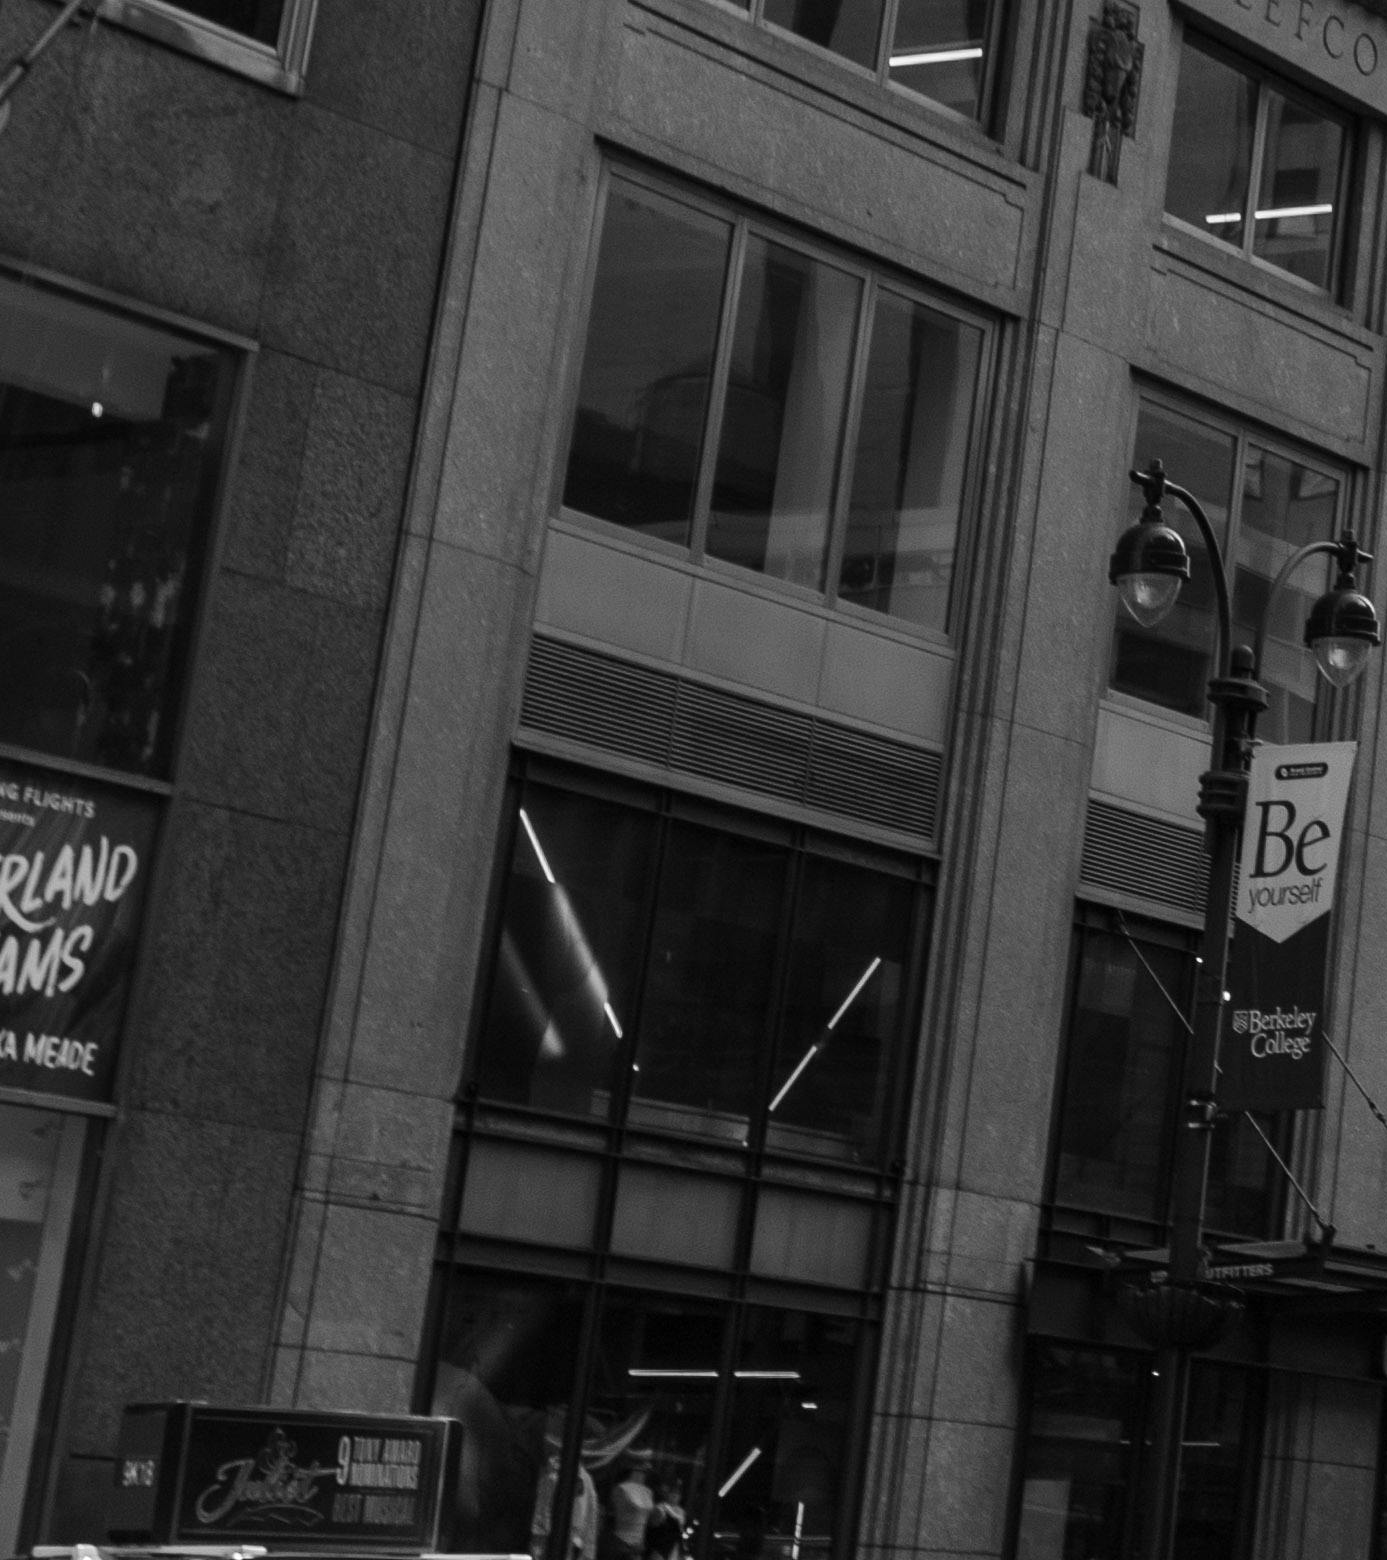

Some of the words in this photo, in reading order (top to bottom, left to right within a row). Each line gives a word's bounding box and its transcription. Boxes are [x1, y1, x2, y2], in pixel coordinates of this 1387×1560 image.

[23, 786, 96, 818] FLIGHTS
[1249, 800, 1330, 878] Be
[0, 835, 138, 933] RLAND
[1247, 878, 1324, 914] yourself
[1249, 1006, 1317, 1035] Berkeley
[22, 1031, 99, 1077] MEADE
[1250, 1031, 1311, 1060] College
[1203, 1263, 1275, 1280] UTFITTERS
[336, 1435, 351, 1486] 9
